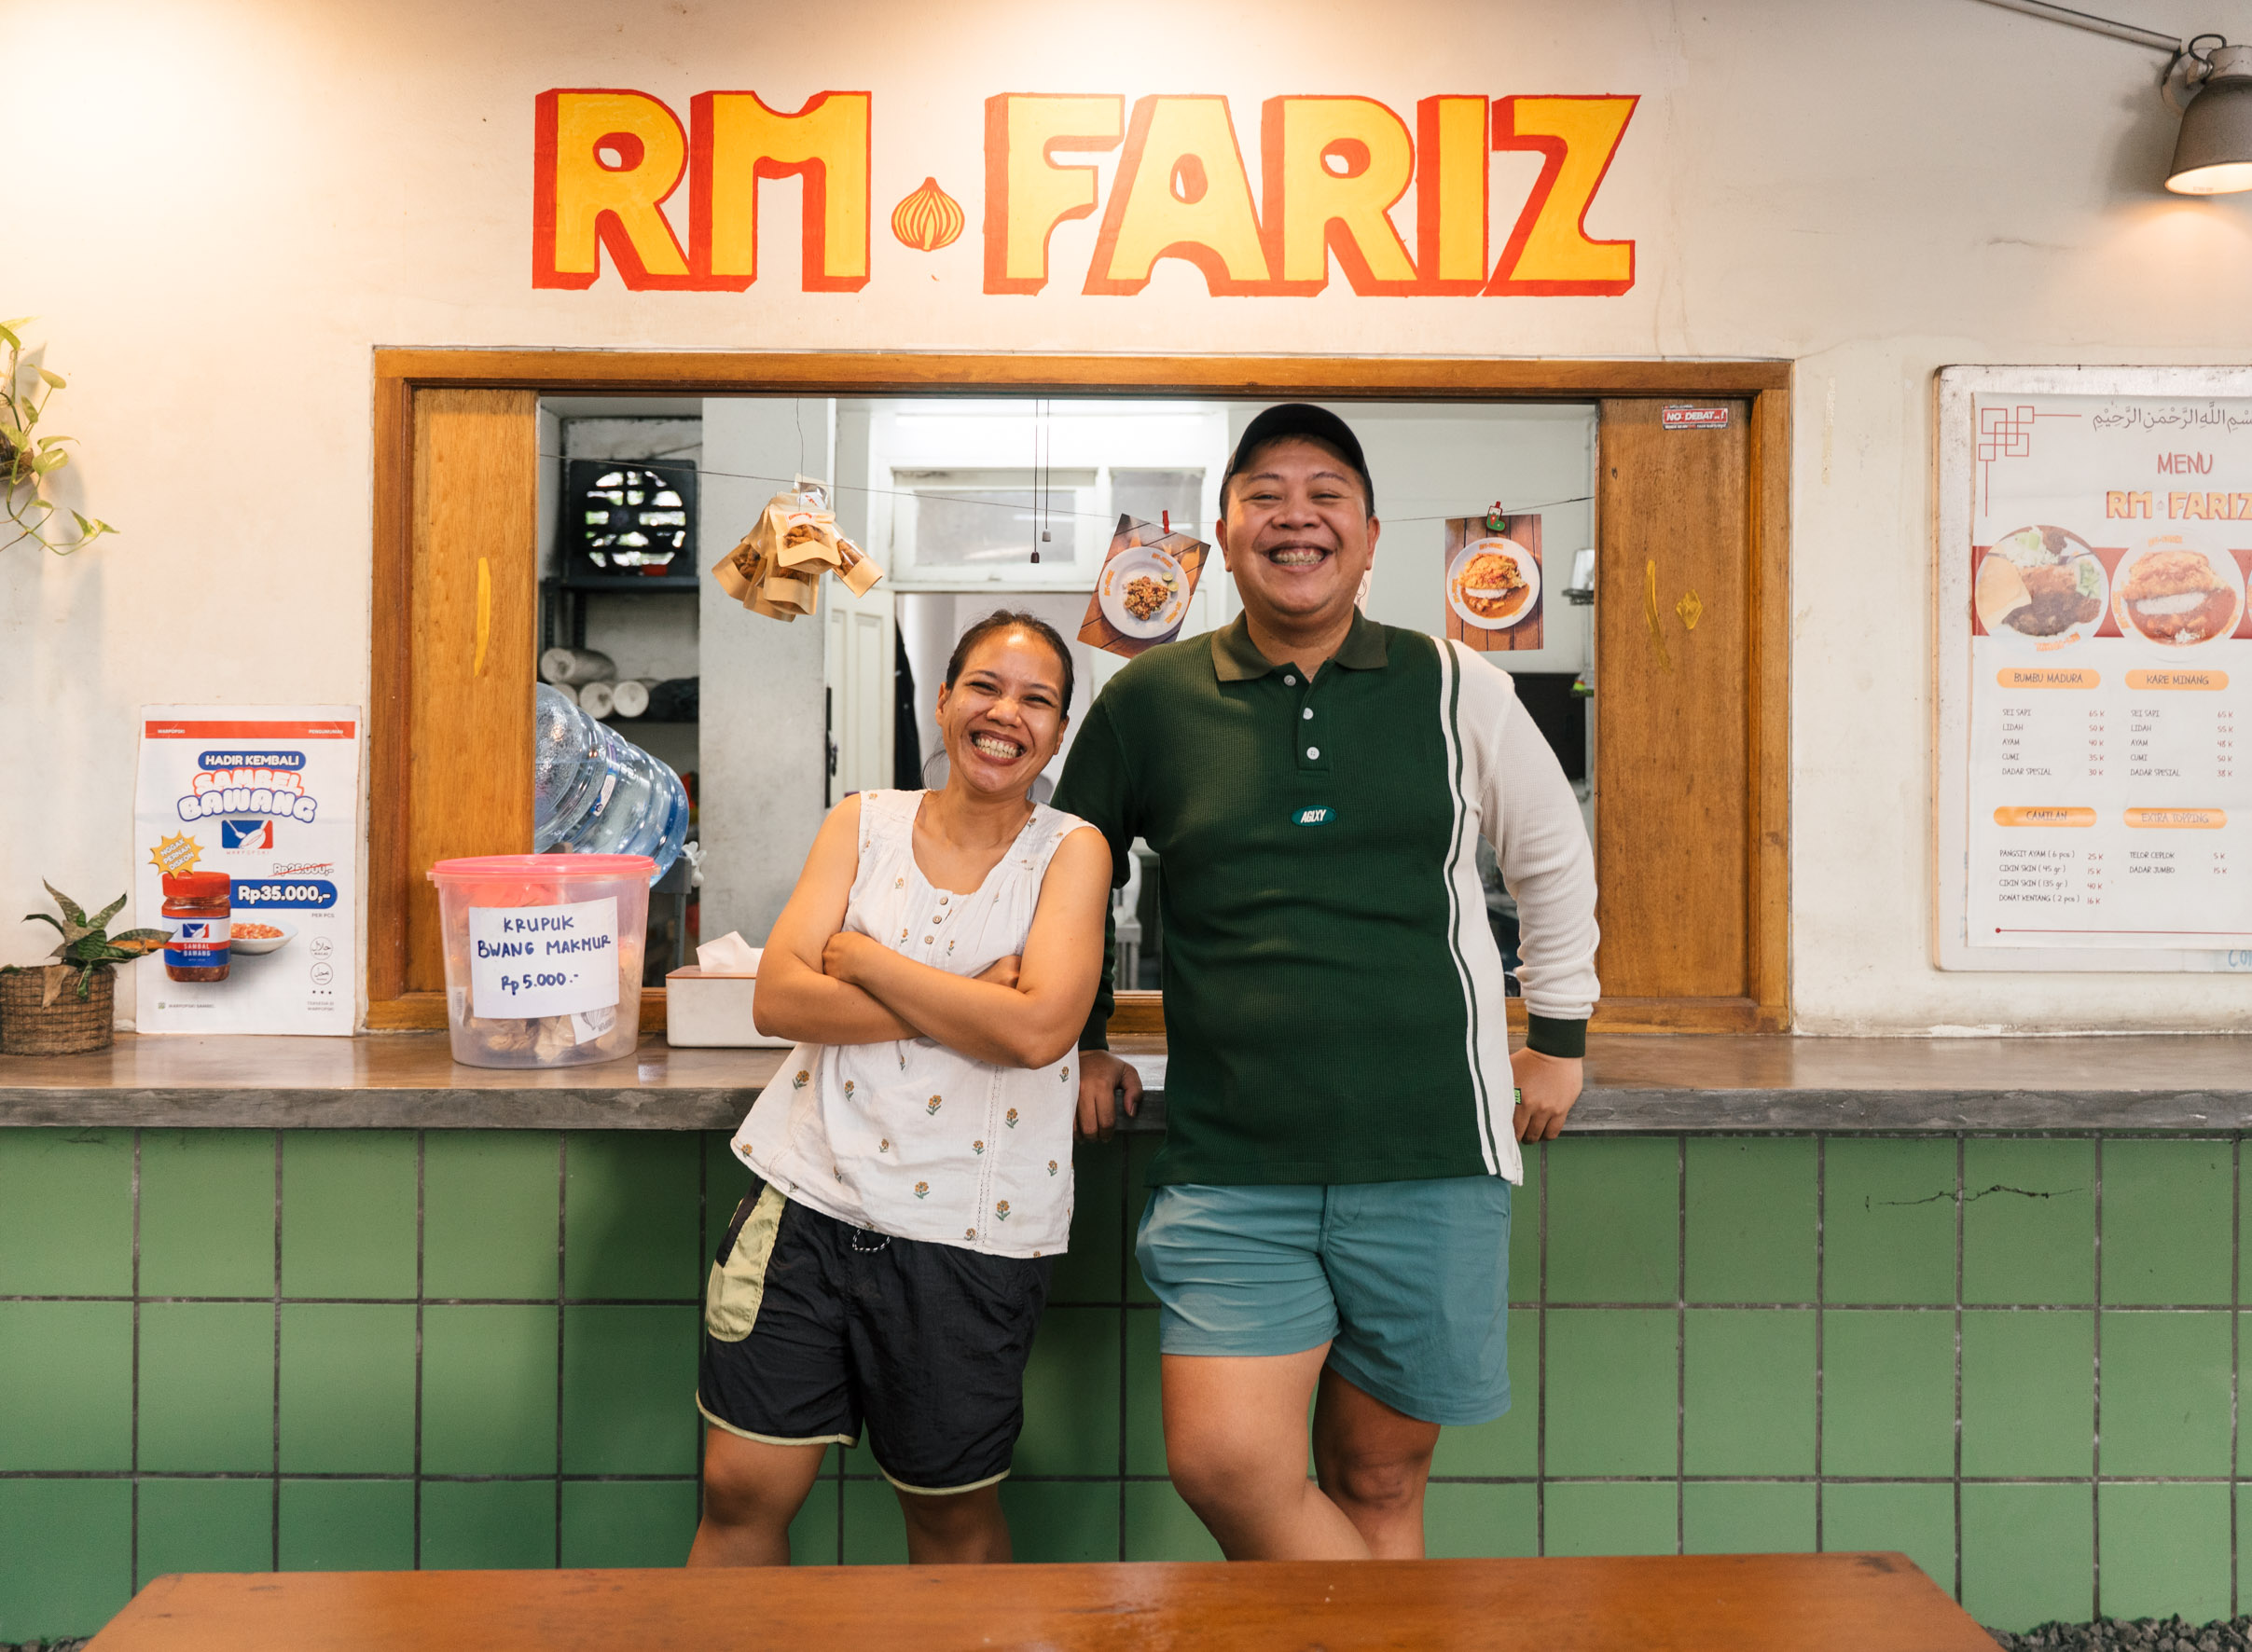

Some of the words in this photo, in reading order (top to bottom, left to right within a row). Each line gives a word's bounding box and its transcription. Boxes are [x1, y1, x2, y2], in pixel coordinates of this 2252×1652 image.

[532, 88, 872, 293] RM
[983, 92, 1641, 296] FARIZ
[1666, 412, 1682, 421] NO
[2157, 451, 2213, 475] MENU
[2106, 490, 2153, 519] RM
[2168, 491, 2252, 520] FARIZ
[2014, 672, 2043, 683] BUMBU
[2047, 673, 2083, 684] MADURA
[2147, 674, 2169, 685] KARE
[2173, 675, 2209, 685] MINANG
[2002, 709, 2014, 717] SEI
[2016, 709, 2032, 717] SAPI
[204, 754, 243, 766] HADIR
[245, 754, 299, 766] KEMBALI
[2130, 753, 2148, 762] CUMI
[2002, 767, 2024, 776] DADAR
[192, 766, 305, 798] SAMBEL
[177, 787, 318, 824] BAWANG
[1300, 808, 1327, 823] AGLXY
[2025, 810, 2067, 821] CAMILAN
[2141, 812, 2169, 823] EXTRA
[2172, 813, 2209, 824] TOPPING
[159, 837, 186, 857] NGGAK
[162, 844, 192, 865] PERNAH
[1999, 849, 2026, 858] PANGSIT
[169, 851, 195, 872] DISKON
[238, 884, 331, 905] Rp35.000,-
[2022, 894, 2052, 902] KENTANG
[503, 915, 574, 933] KRUPUK
[477, 939, 534, 958] BWANG
[546, 934, 612, 956] MAKMUR
